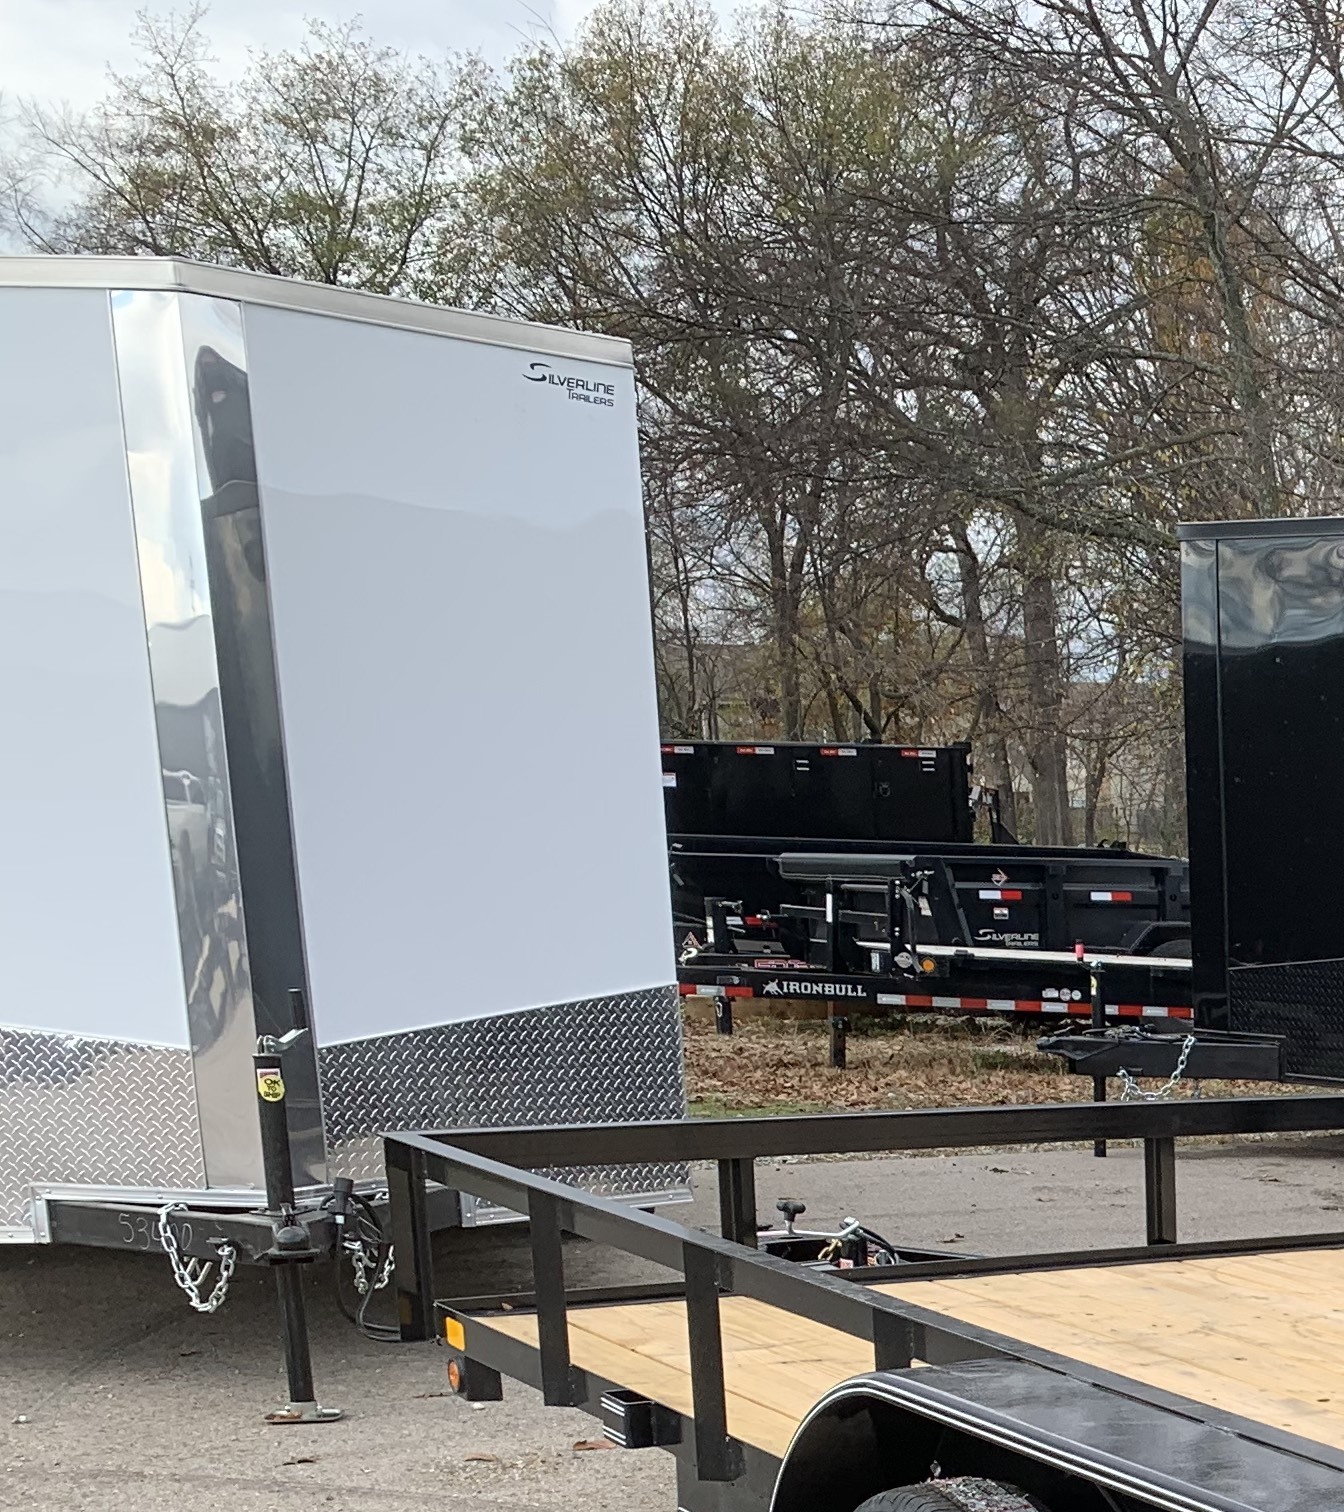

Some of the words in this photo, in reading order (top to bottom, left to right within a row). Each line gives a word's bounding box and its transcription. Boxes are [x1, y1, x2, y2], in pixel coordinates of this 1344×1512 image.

[522, 362, 615, 396] SILVERLINE
[566, 388, 615, 407] TRAILERS
[782, 981, 867, 998] IRONBULL
[264, 1078, 280, 1086] OK
